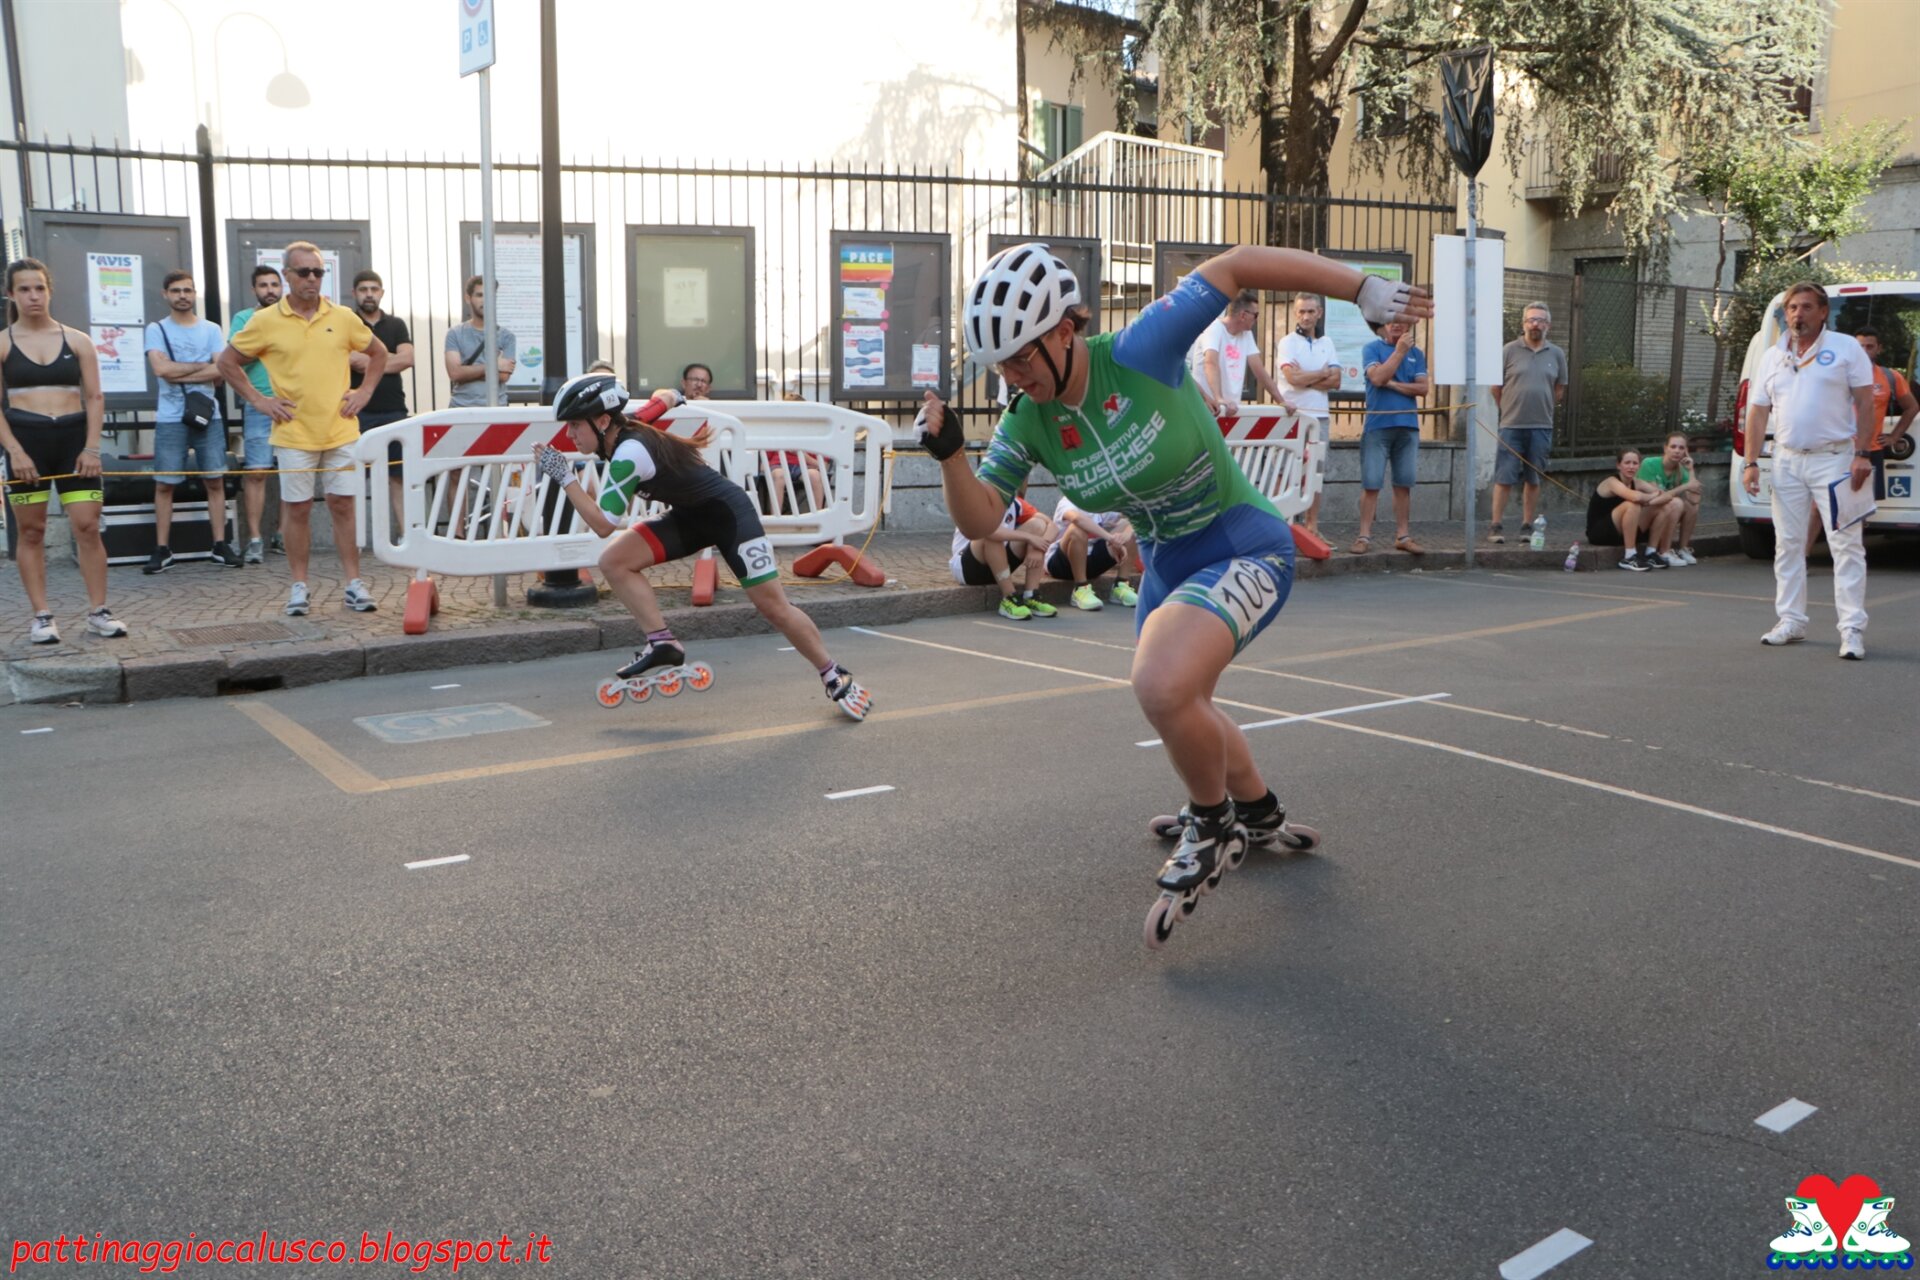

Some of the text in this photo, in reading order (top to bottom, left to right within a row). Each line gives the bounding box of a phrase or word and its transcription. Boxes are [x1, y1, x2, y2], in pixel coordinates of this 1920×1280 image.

[96, 255, 132, 267] AVIS
[850, 252, 884, 263] PACE
[606, 393, 616, 405] 92
[1056, 410, 1166, 491] CALUSCHESE
[745, 543, 772, 570] 92
